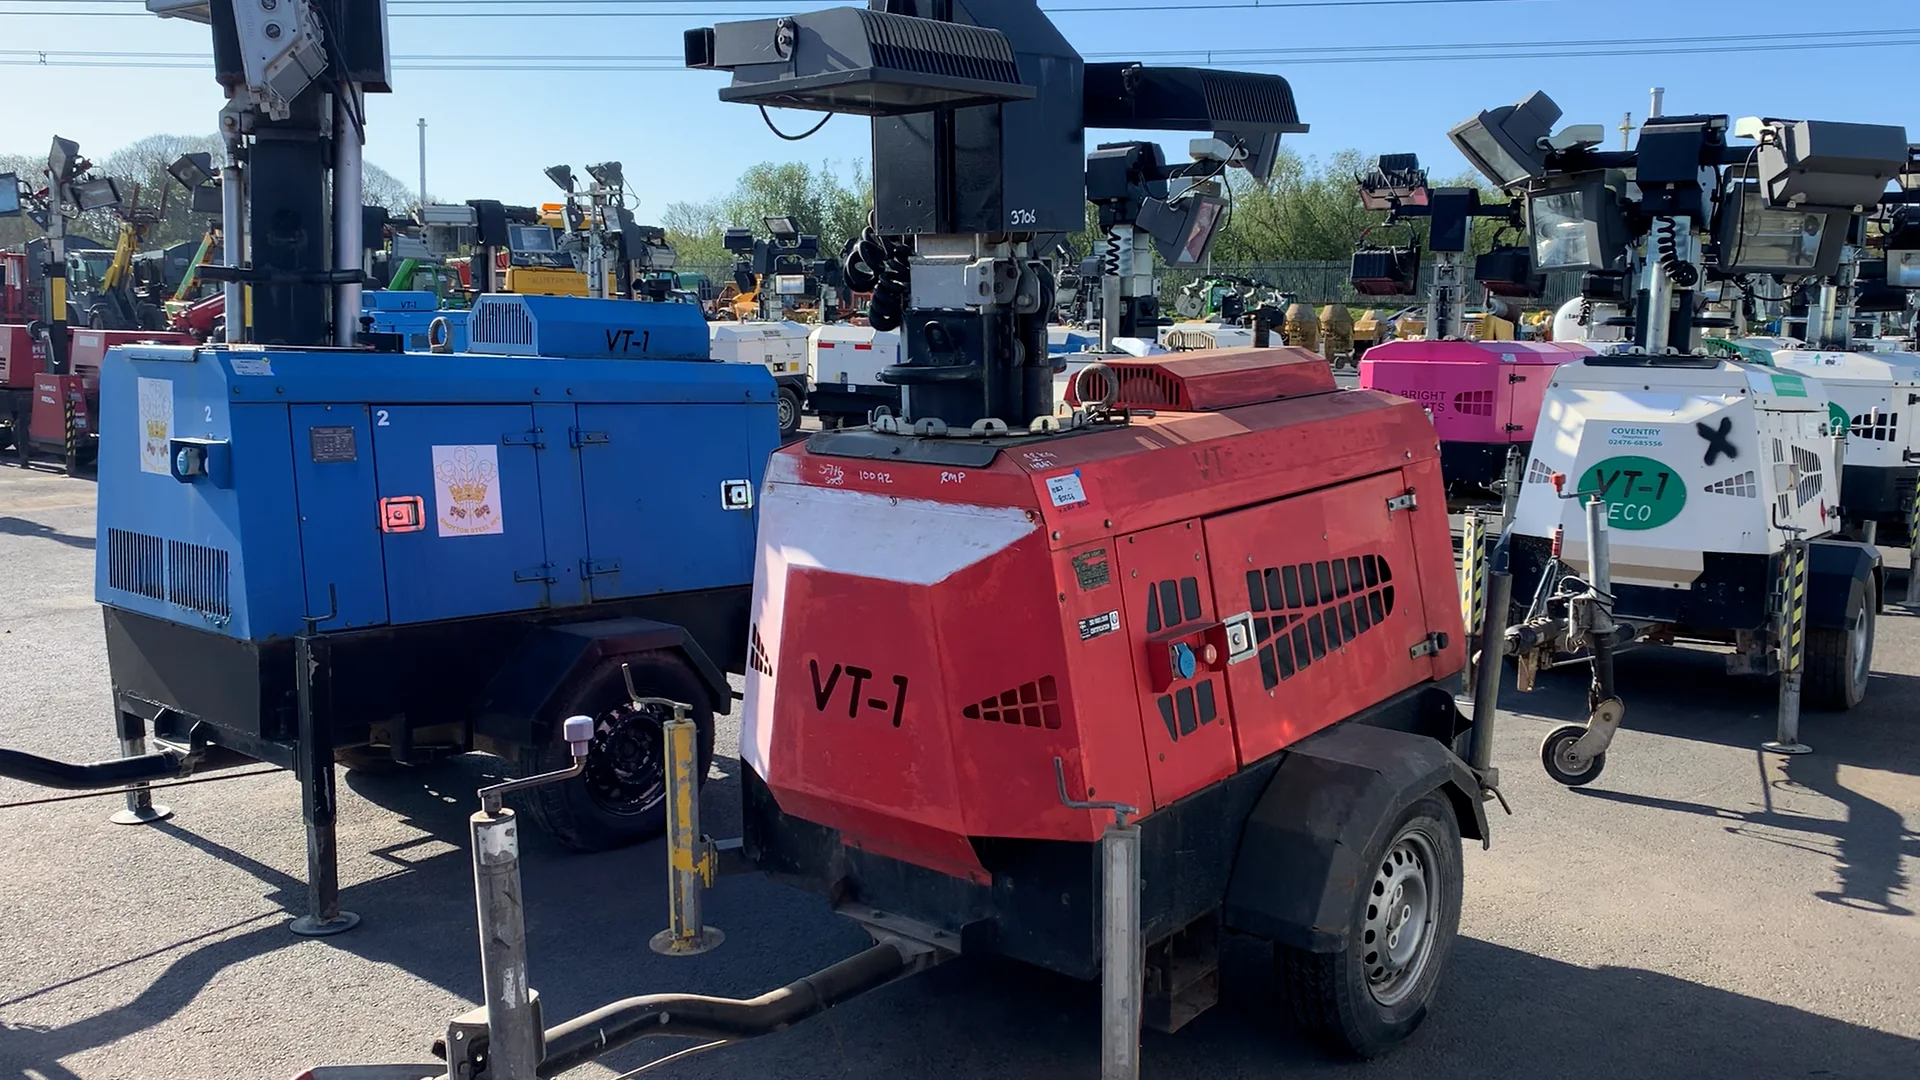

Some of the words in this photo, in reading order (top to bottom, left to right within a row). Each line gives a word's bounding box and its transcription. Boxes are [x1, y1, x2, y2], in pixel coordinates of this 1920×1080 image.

[1010, 208, 1037, 225] 3706
[400, 301, 417, 309] VT-1
[606, 329, 650, 352] VT-1
[1401, 390, 1446, 401] BRIGHT
[204, 405, 212, 422] 2
[376, 409, 390, 426] 2
[1611, 427, 1661, 436] COVENTRY
[940, 471, 966, 484] RMP
[1596, 469, 1669, 500] VT-1
[1608, 502, 1652, 521] ECO
[809, 659, 909, 728] VT-1
